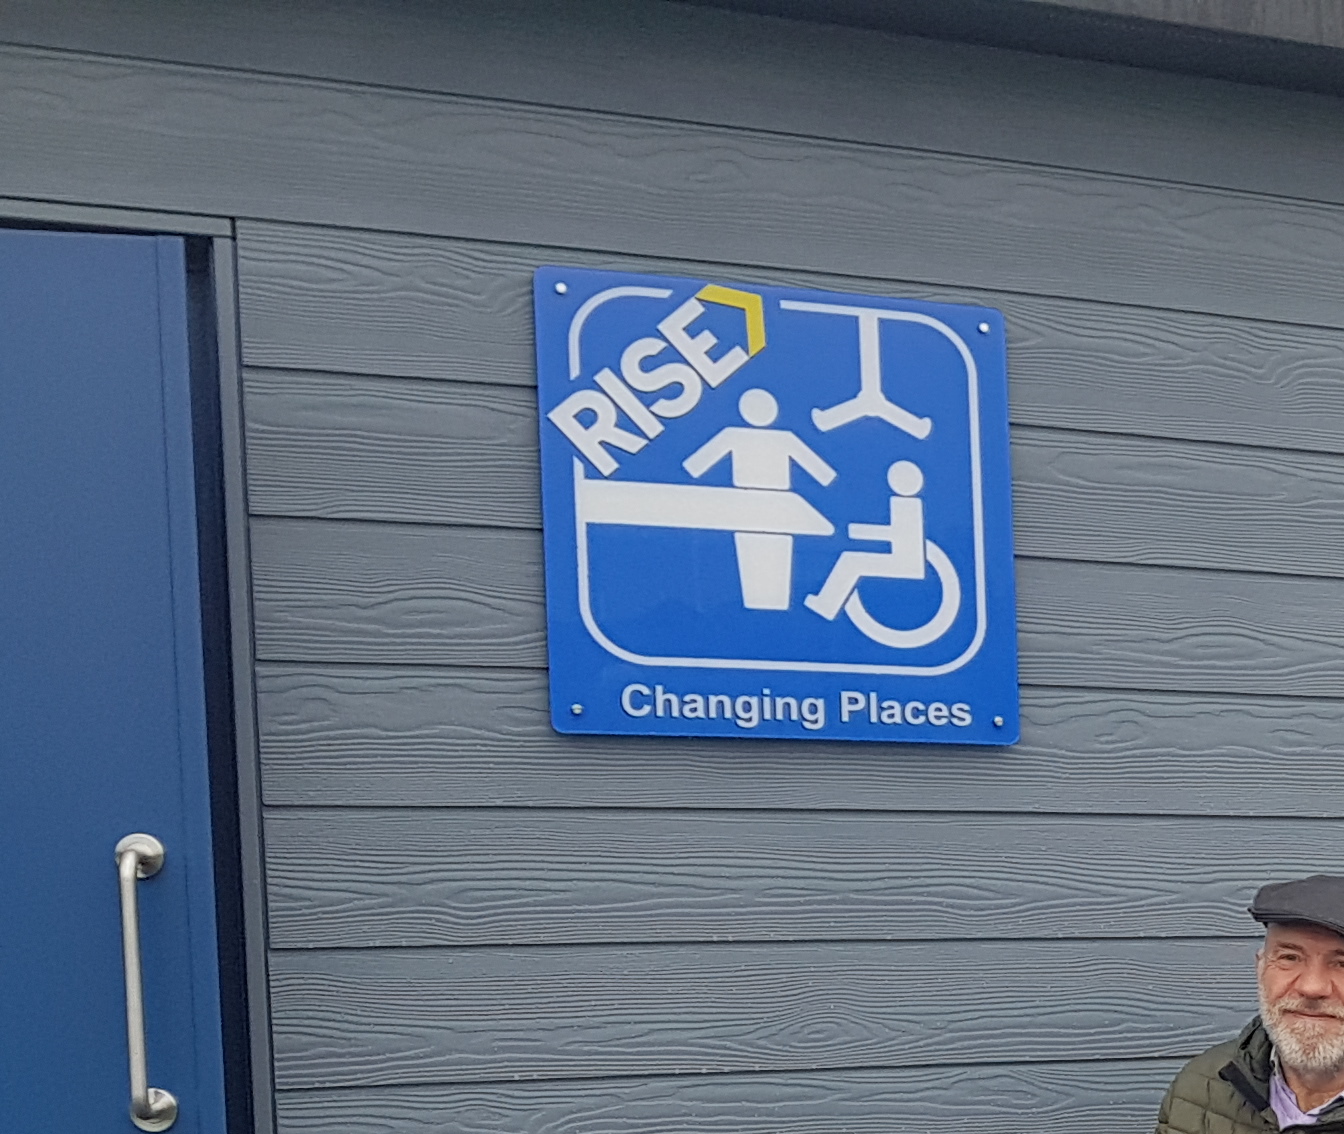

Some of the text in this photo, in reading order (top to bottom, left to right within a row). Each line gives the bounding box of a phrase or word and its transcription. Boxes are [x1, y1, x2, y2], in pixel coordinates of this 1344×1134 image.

[547, 299, 751, 477] RISE
[621, 684, 973, 730] Changing Places
